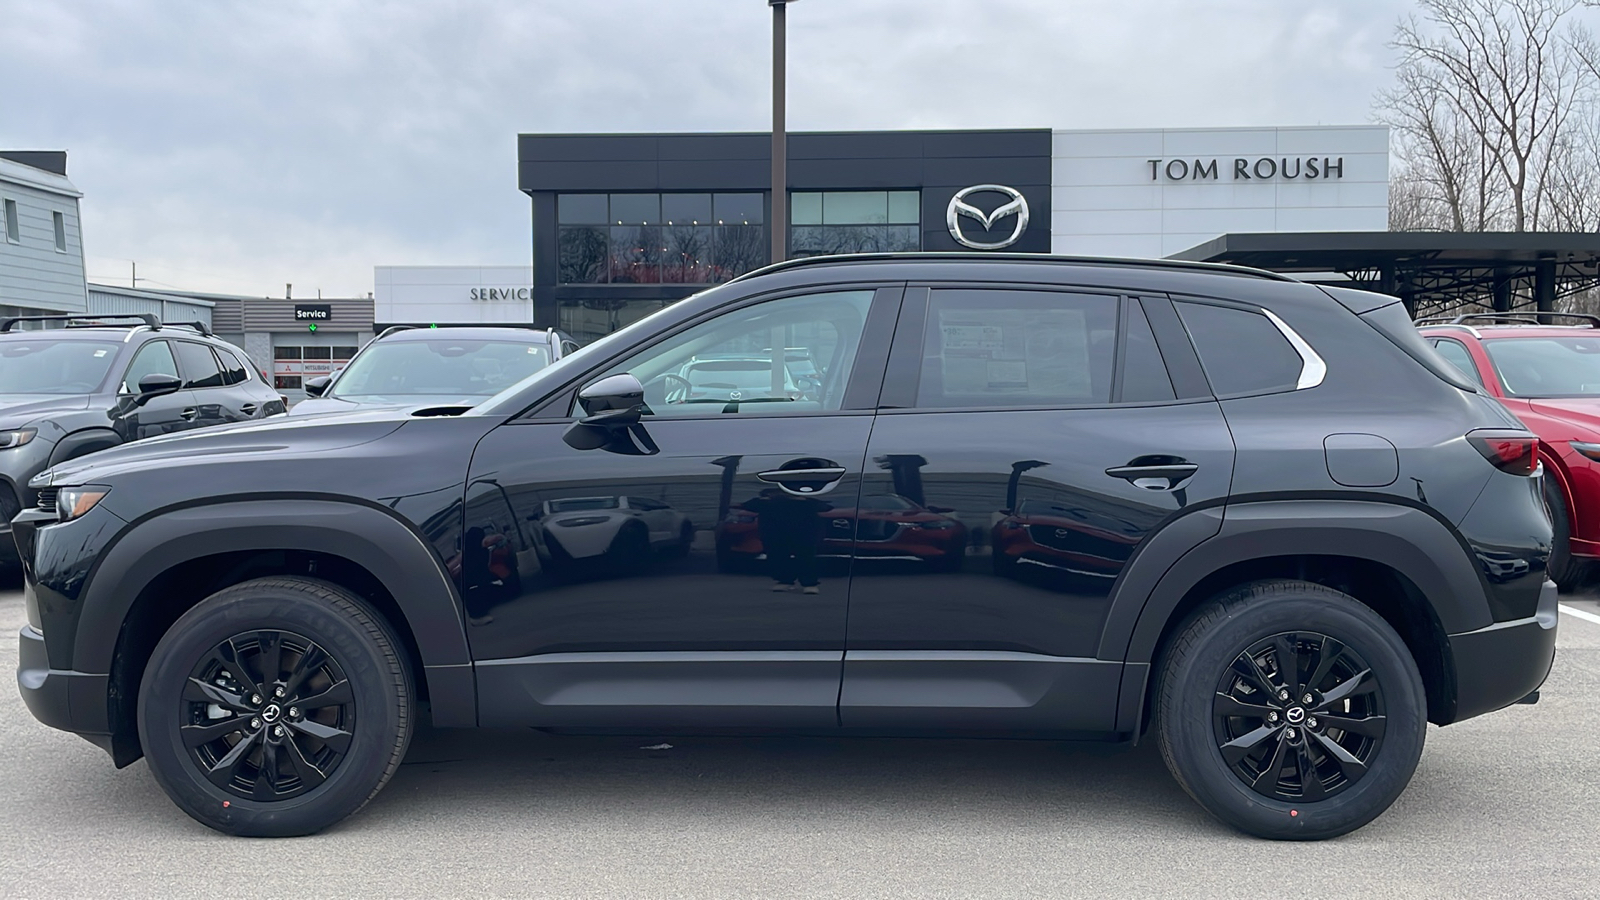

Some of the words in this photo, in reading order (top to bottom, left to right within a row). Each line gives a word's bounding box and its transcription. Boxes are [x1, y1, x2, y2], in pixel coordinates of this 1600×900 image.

[1147, 159, 1219, 180] TOM
[1234, 157, 1343, 179] ROUSH
[296, 310, 327, 319] Service
